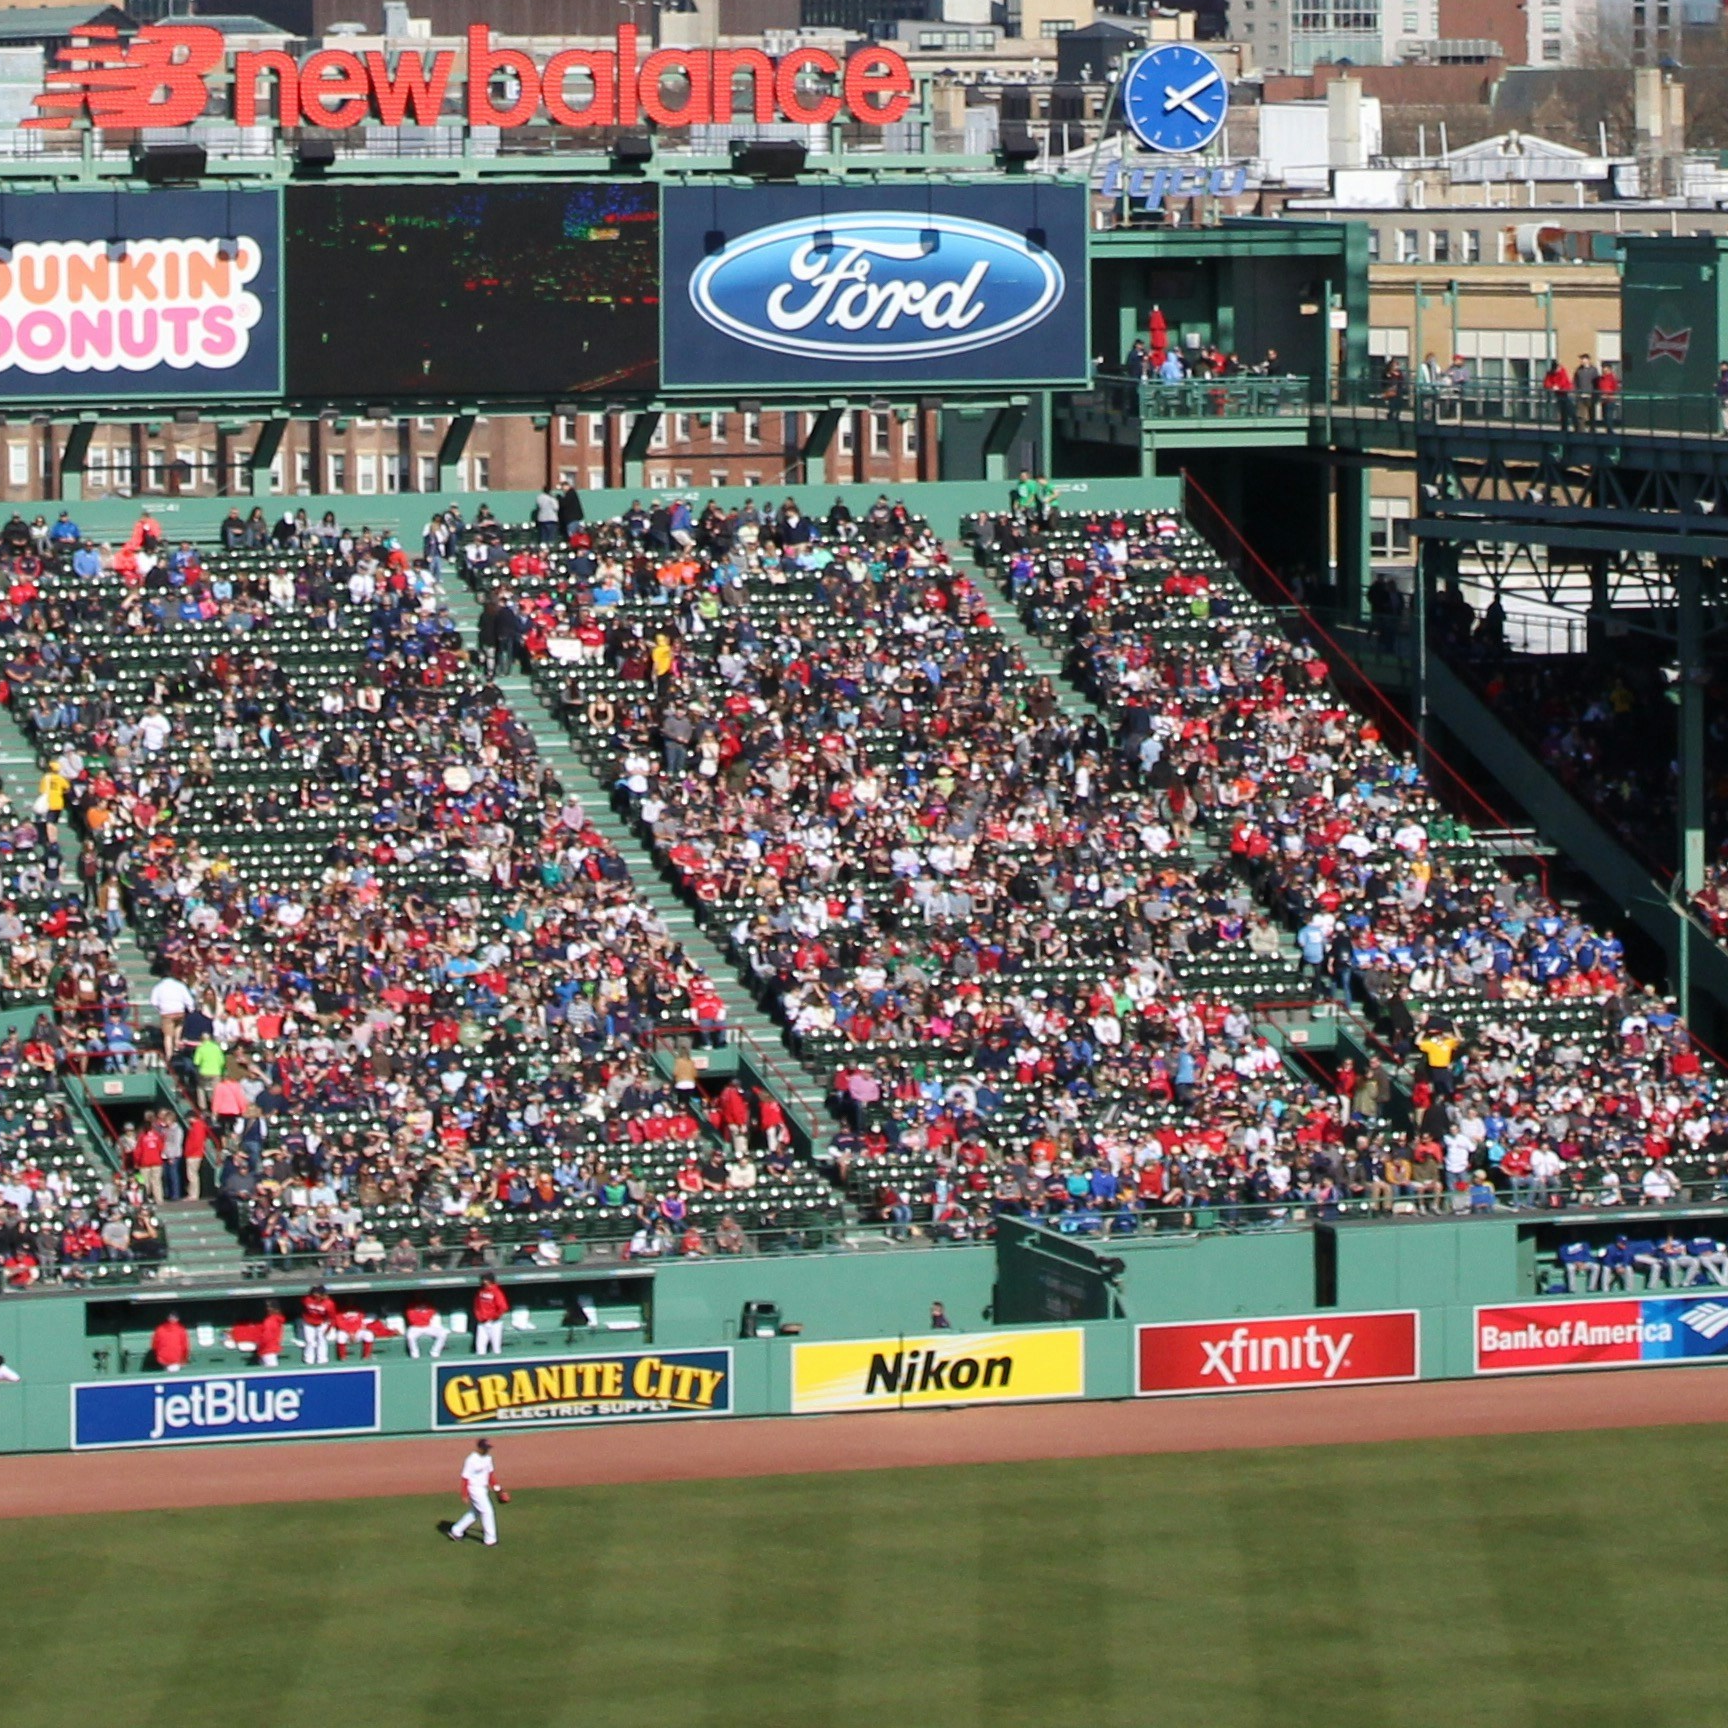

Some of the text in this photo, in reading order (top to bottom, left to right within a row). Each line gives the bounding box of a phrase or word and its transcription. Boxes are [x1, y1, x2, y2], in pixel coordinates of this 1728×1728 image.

[234, 49, 459, 129] new
[468, 23, 913, 128] balance
[1101, 159, 1247, 212] tyco
[766, 230, 990, 336] Ford
[1199, 1324, 1355, 1385] xfinity
[1481, 1318, 1673, 1352] Bank of America
[443, 1356, 725, 1419] GRANITE CITY
[865, 1349, 1014, 1395] Nikon
[149, 1379, 301, 1440] jetBlue
[495, 1399, 673, 1421] ELECTRIC SUPPLY
